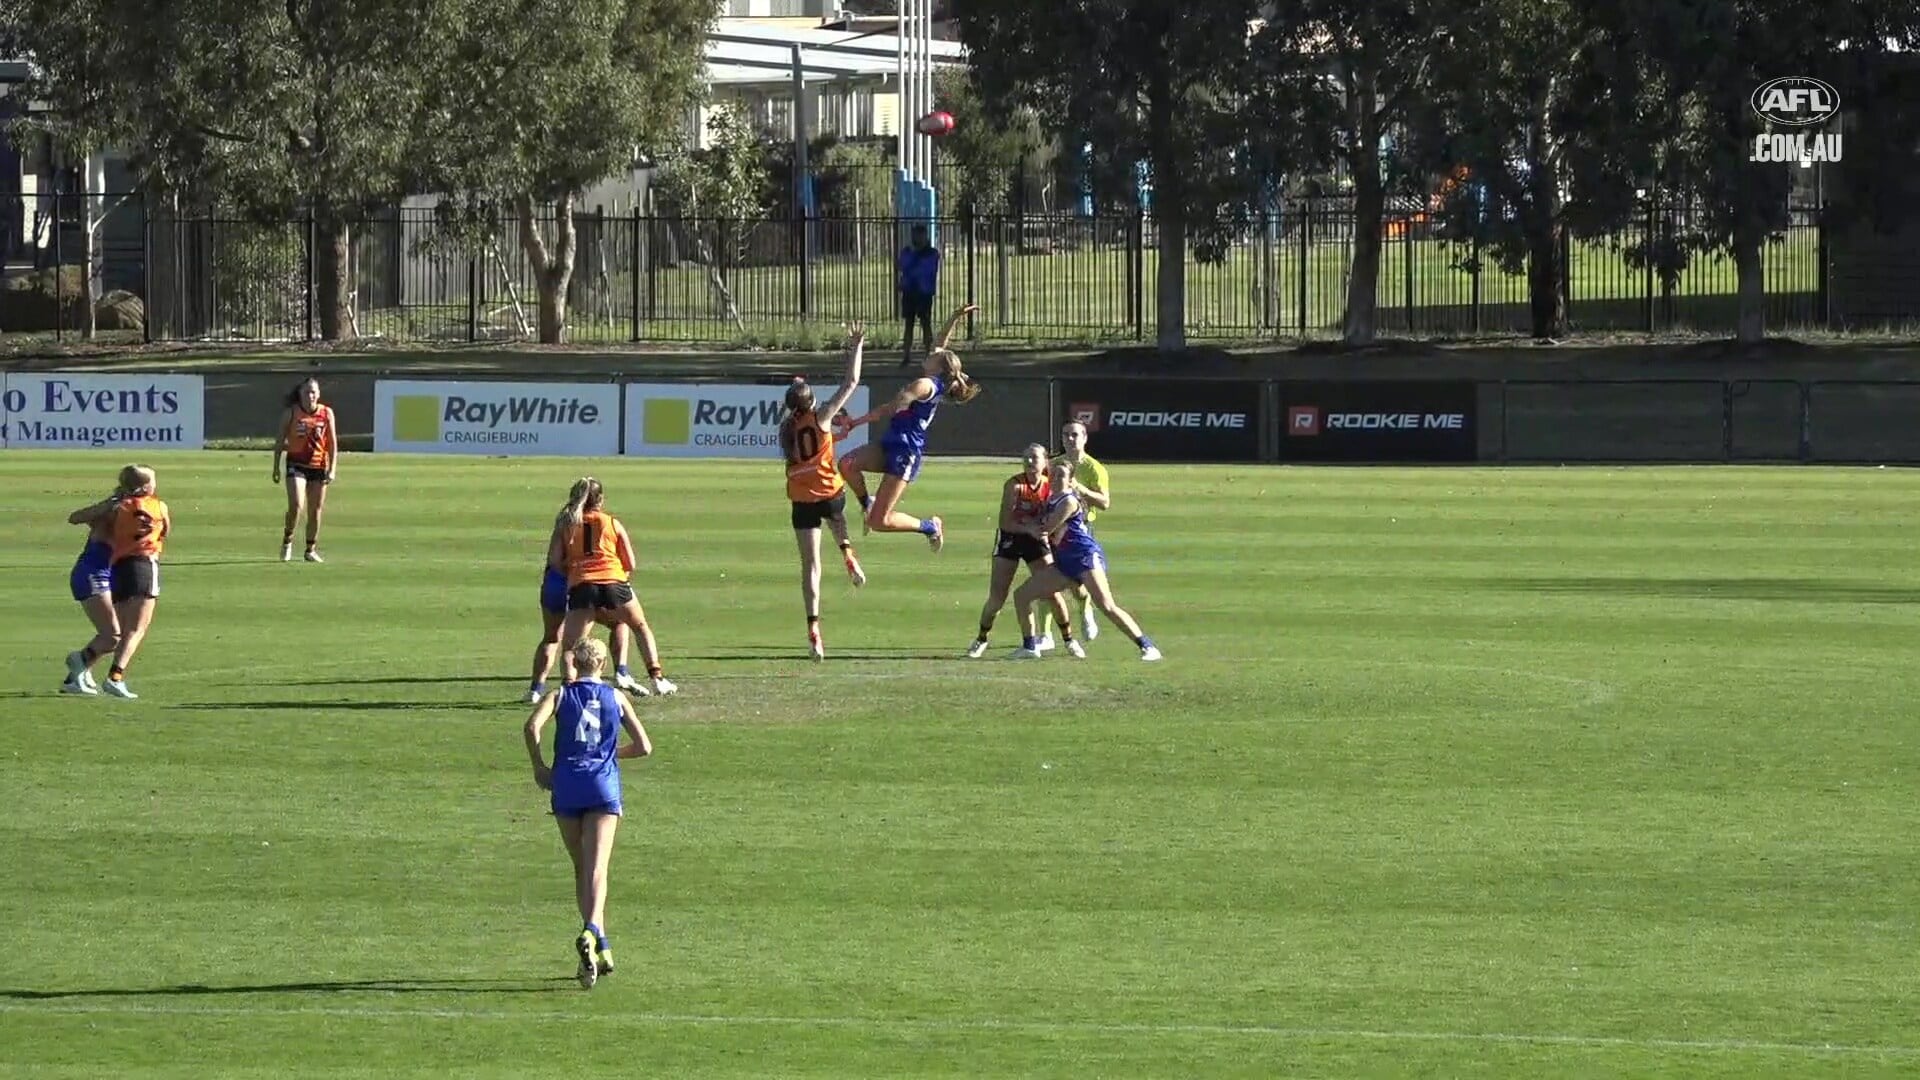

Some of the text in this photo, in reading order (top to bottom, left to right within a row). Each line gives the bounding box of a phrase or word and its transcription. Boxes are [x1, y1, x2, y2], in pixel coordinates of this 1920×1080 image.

[41, 380, 179, 414] Events
[1109, 411, 1201, 427] ROOKIE
[1206, 412, 1246, 428] ME
[1326, 413, 1420, 429] ROOKIE
[1423, 413, 1464, 429] ME
[17, 420, 184, 447] Management
[444, 430, 540, 444] CRAIGIEBURN
[694, 433, 778, 447] CRAIGIEBUR
